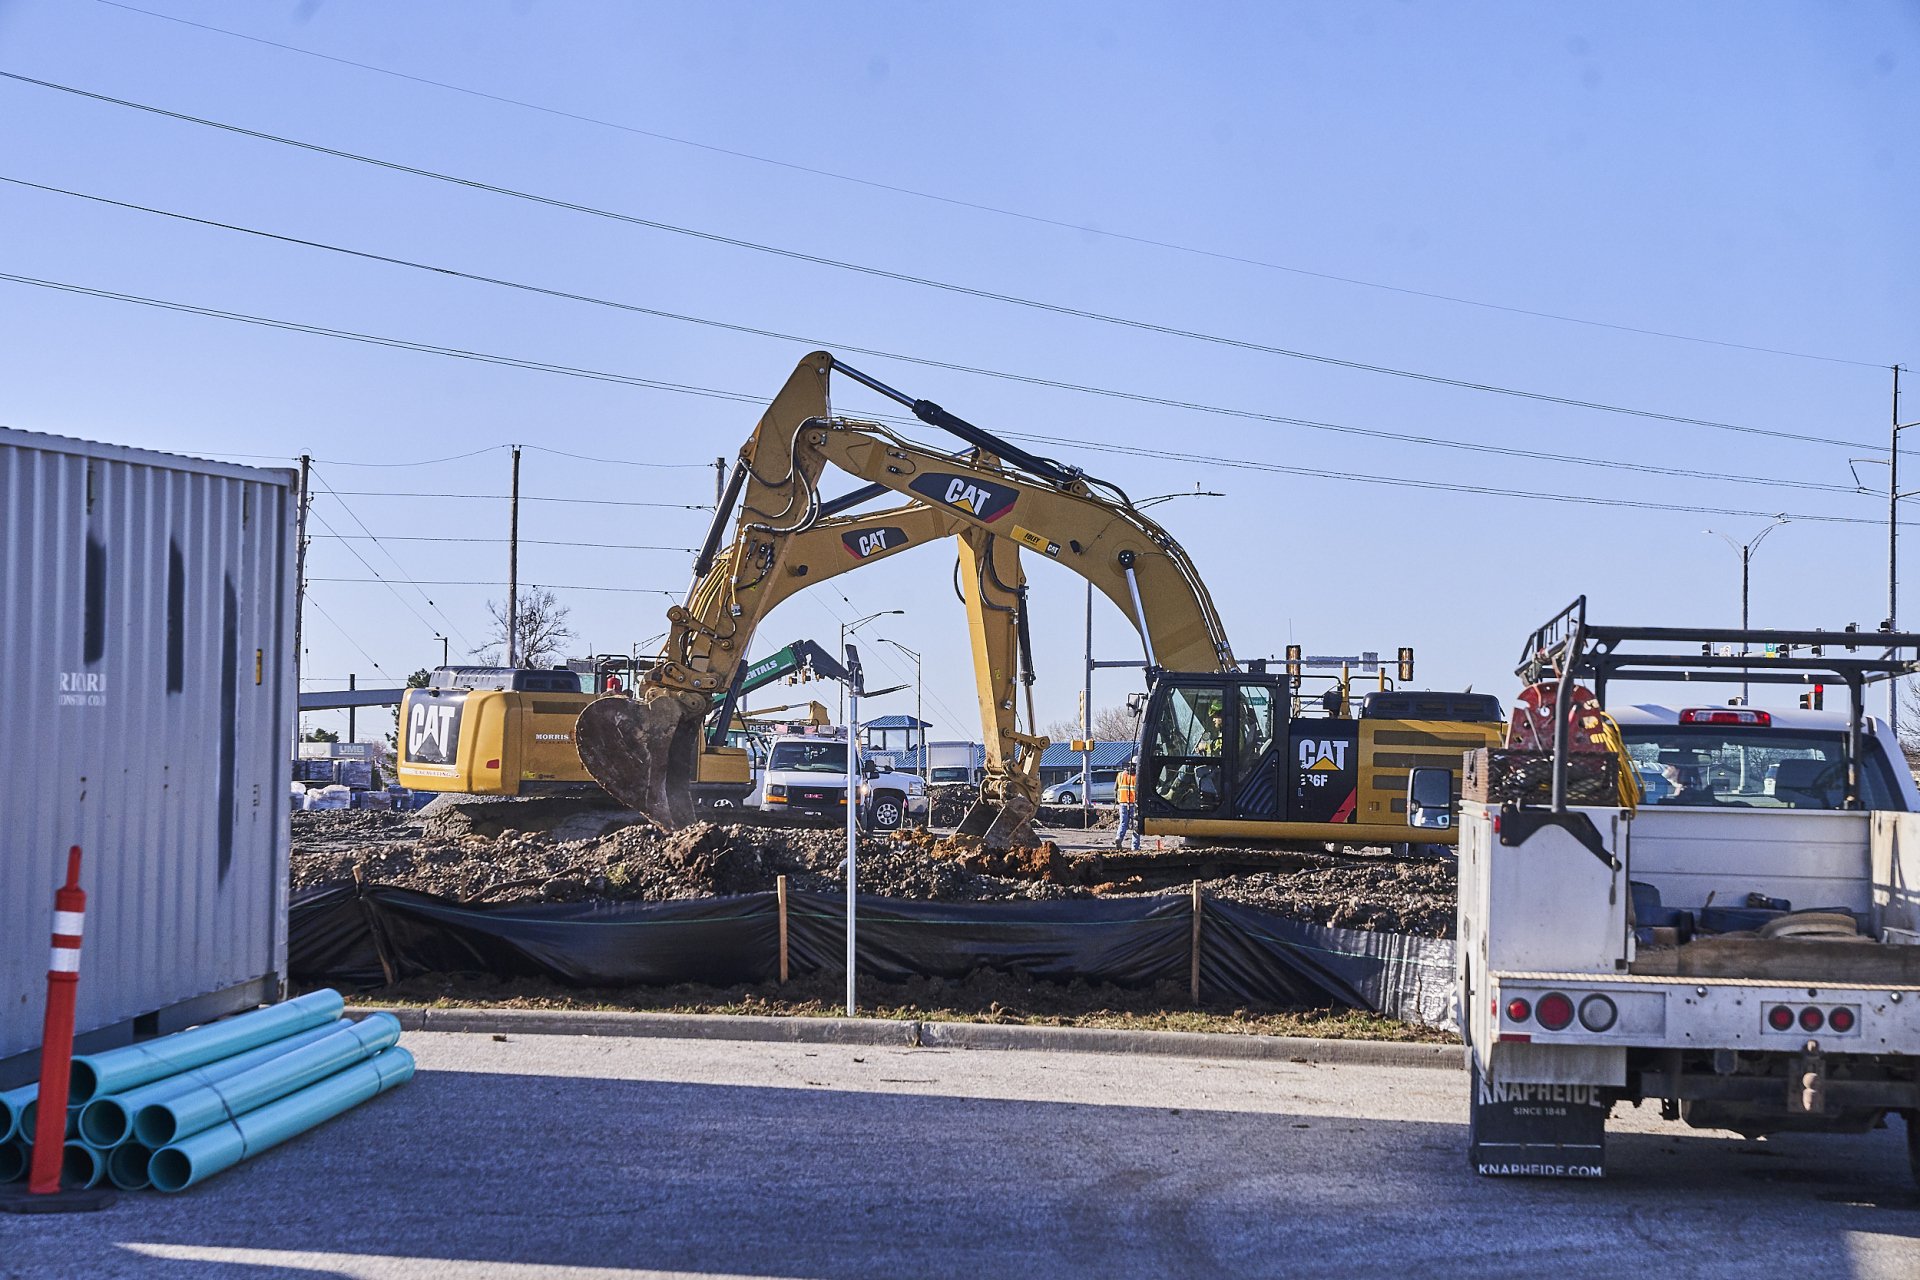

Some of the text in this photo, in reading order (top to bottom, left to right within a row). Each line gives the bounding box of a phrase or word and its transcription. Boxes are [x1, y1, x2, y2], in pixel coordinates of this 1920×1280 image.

[944, 478, 991, 516] CAT
[858, 529, 886, 557] CAT
[1047, 544, 1059, 554] CAT
[745, 660, 778, 680] ENTALS
[409, 703, 456, 758] CAT
[338, 745, 365, 753] UMB
[1299, 739, 1349, 771] CAT
[1513, 1107, 1567, 1117] SINCE 1848
